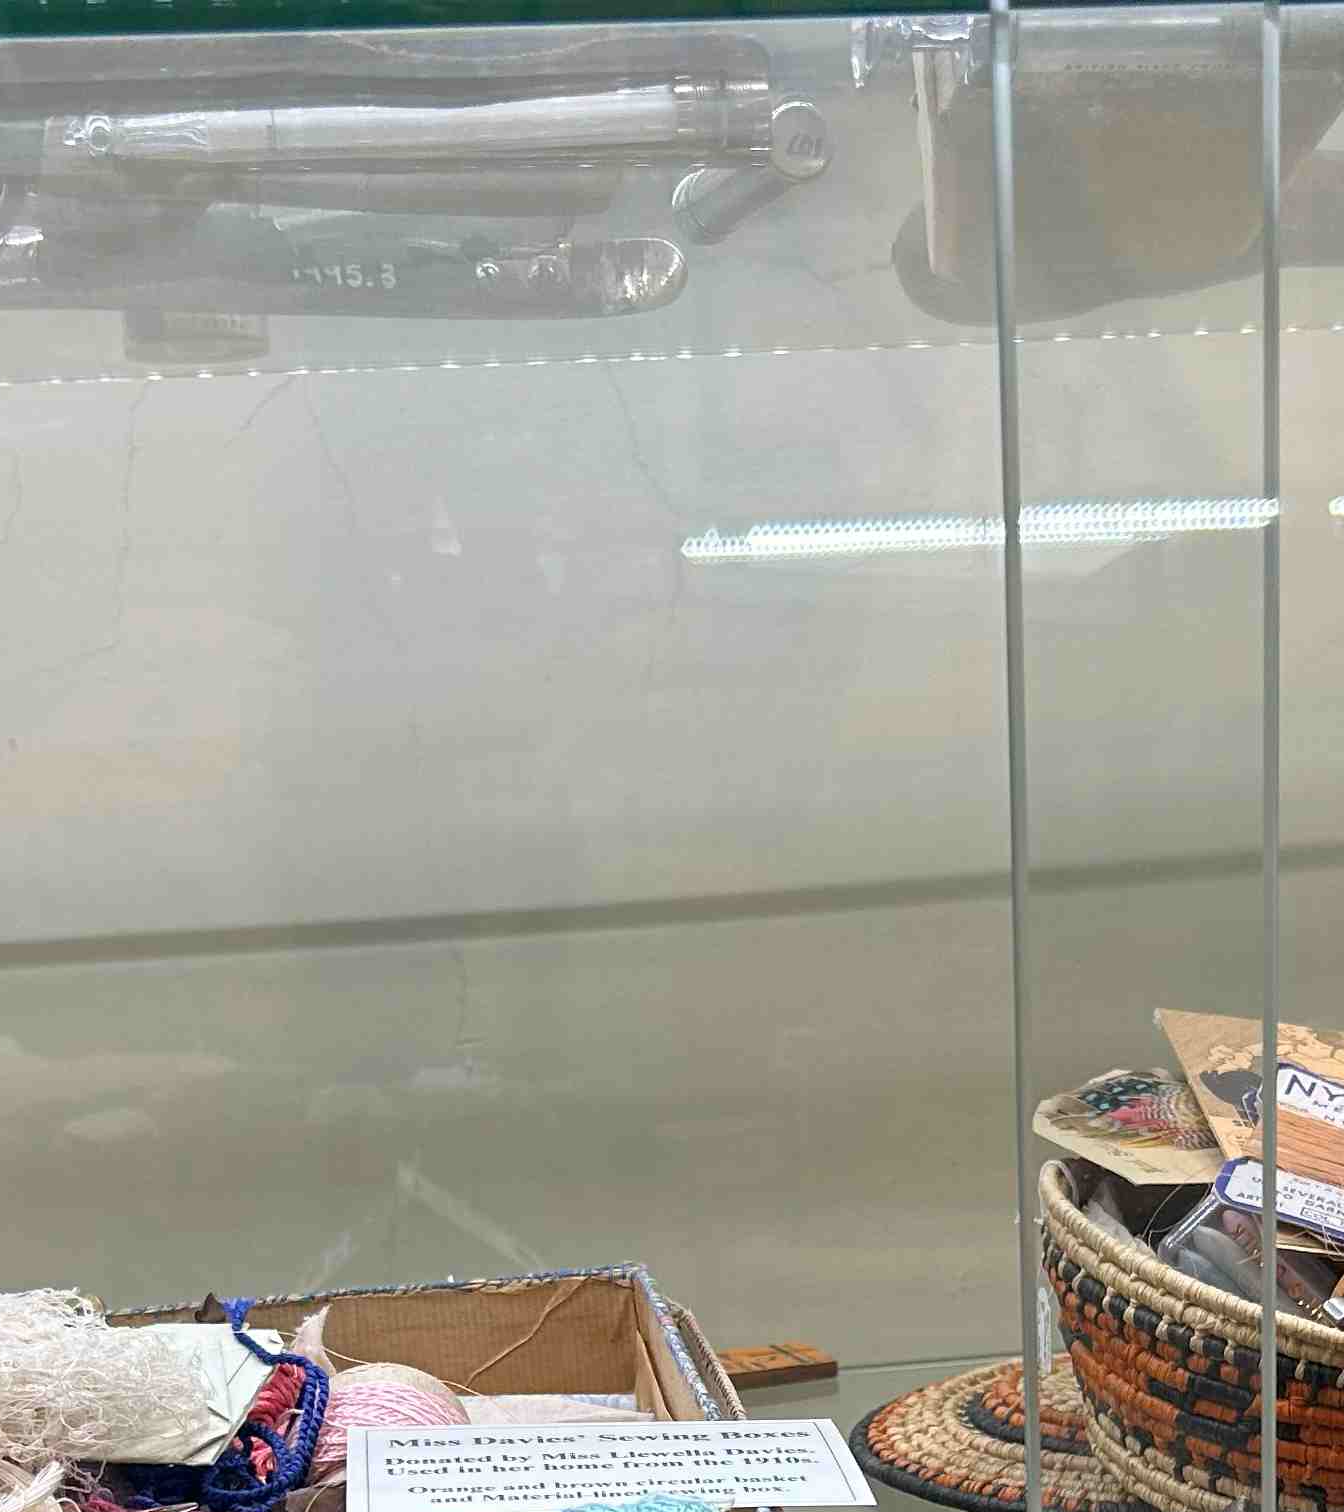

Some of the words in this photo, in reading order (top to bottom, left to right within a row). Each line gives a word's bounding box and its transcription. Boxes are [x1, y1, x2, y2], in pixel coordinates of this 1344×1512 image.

[388, 1438, 462, 1448] Miss
[472, 1434, 585, 1446] Davies'
[597, 1432, 710, 1442] Sewing
[721, 1430, 810, 1440] Boxes
[385, 1455, 492, 1466] Donated
[502, 1454, 531, 1464] by
[542, 1452, 600, 1461] Miss
[610, 1449, 716, 1459] Llewella
[724, 1447, 815, 1456] Davies.
[387, 1466, 448, 1476] Used
[458, 1465, 482, 1474] in
[492, 1464, 535, 1473] her
[543, 1461, 614, 1471] home
[623, 1459, 684, 1469] from
[694, 1457, 734, 1467] the
[743, 1455, 819, 1465] 1910s.
[407, 1485, 496, 1495] Orange
[503, 1482, 546, 1491] and
[555, 1479, 628, 1489] brown
[636, 1477, 727, 1487] circular
[734, 1475, 807, 1485] basket
[430, 1495, 472, 1504] and
[743, 1485, 792, 1493] box.
